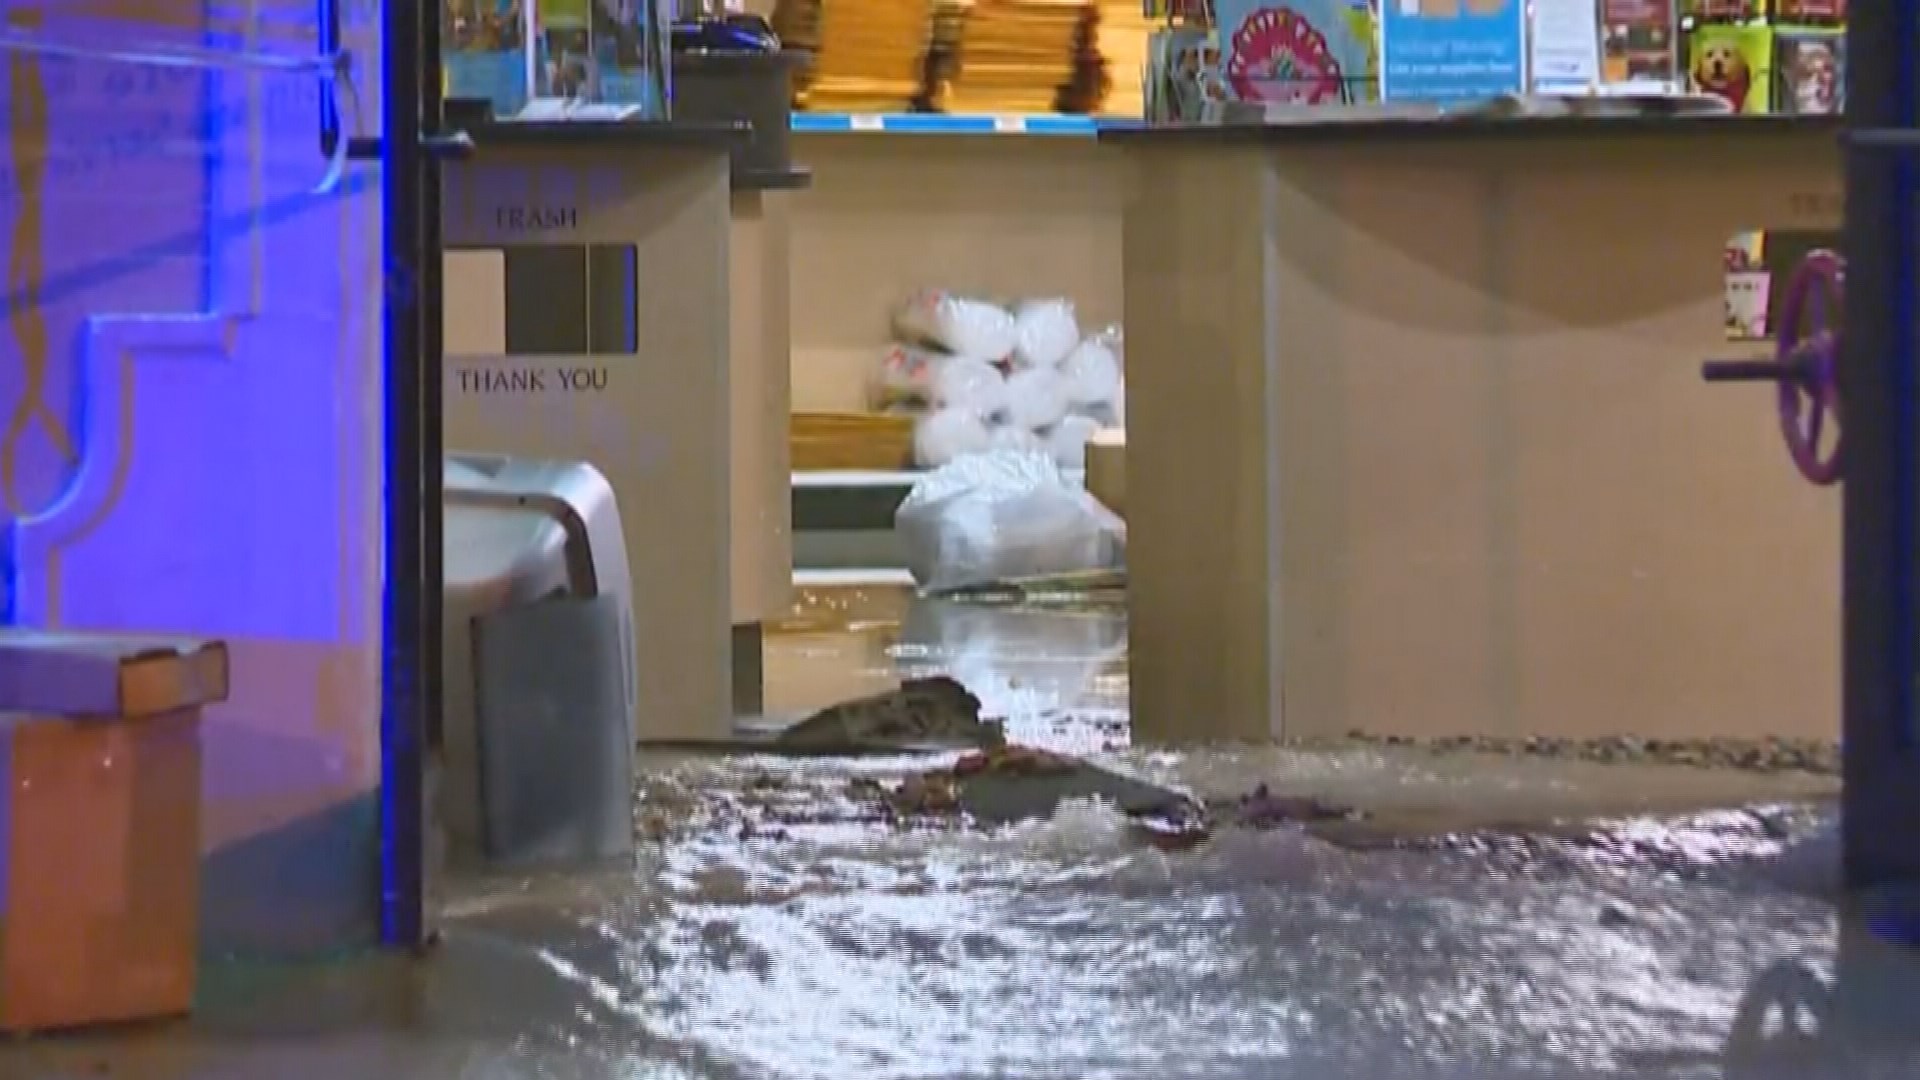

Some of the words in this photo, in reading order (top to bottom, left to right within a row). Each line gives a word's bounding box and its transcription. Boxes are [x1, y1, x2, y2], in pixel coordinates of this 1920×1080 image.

[496, 207, 577, 230] TRASH
[457, 368, 545, 393] THANK
[558, 367, 608, 391] YOU
